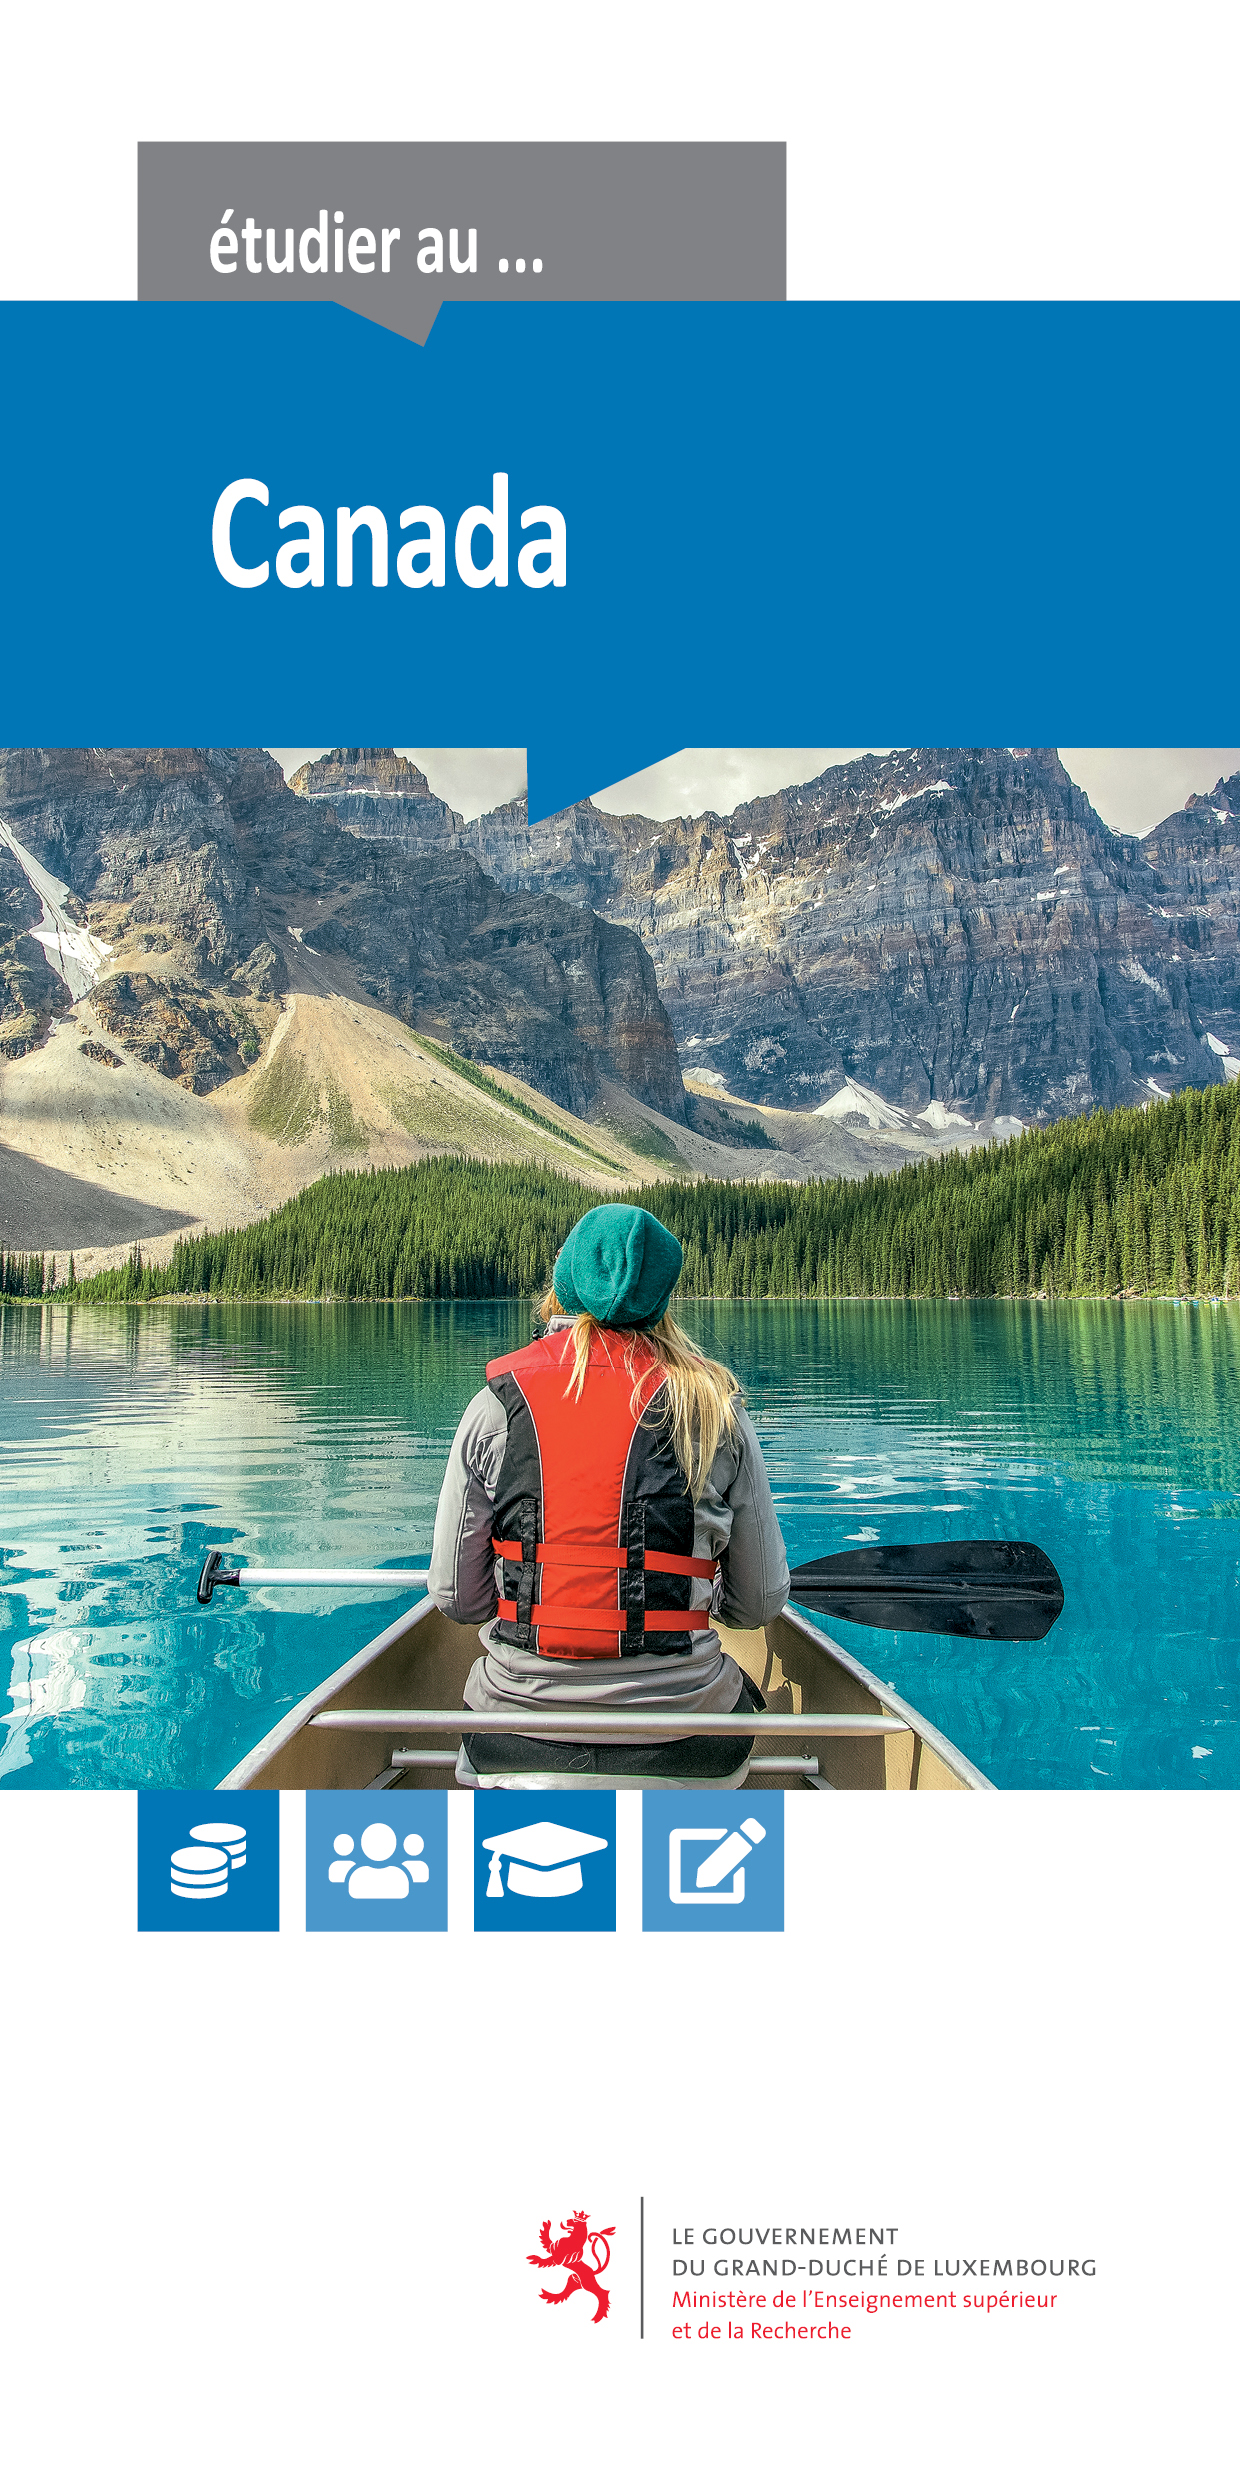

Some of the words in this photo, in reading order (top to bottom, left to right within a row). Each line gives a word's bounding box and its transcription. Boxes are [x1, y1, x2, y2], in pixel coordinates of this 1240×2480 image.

[209, 208, 401, 274] étudier
[416, 227, 478, 274] au
[211, 471, 567, 589] Canada
[672, 2227, 695, 2245] LE
[702, 2227, 899, 2246] GOUVERNEMENT
[672, 2259, 705, 2277] DU
[713, 2253, 888, 2277] GRAND-DUCHÉ
[897, 2259, 925, 2277] DE
[934, 2259, 1096, 2277] LUXEMBOURG
[672, 2289, 767, 2308] Ministère
[772, 2289, 796, 2308] de
[803, 2289, 957, 2314] l’Enseignement
[963, 2290, 1058, 2314] supérieur
[672, 2322, 692, 2339] et
[697, 2321, 722, 2339] de
[728, 2321, 744, 2339] la
[751, 2321, 852, 2339] Recherche
